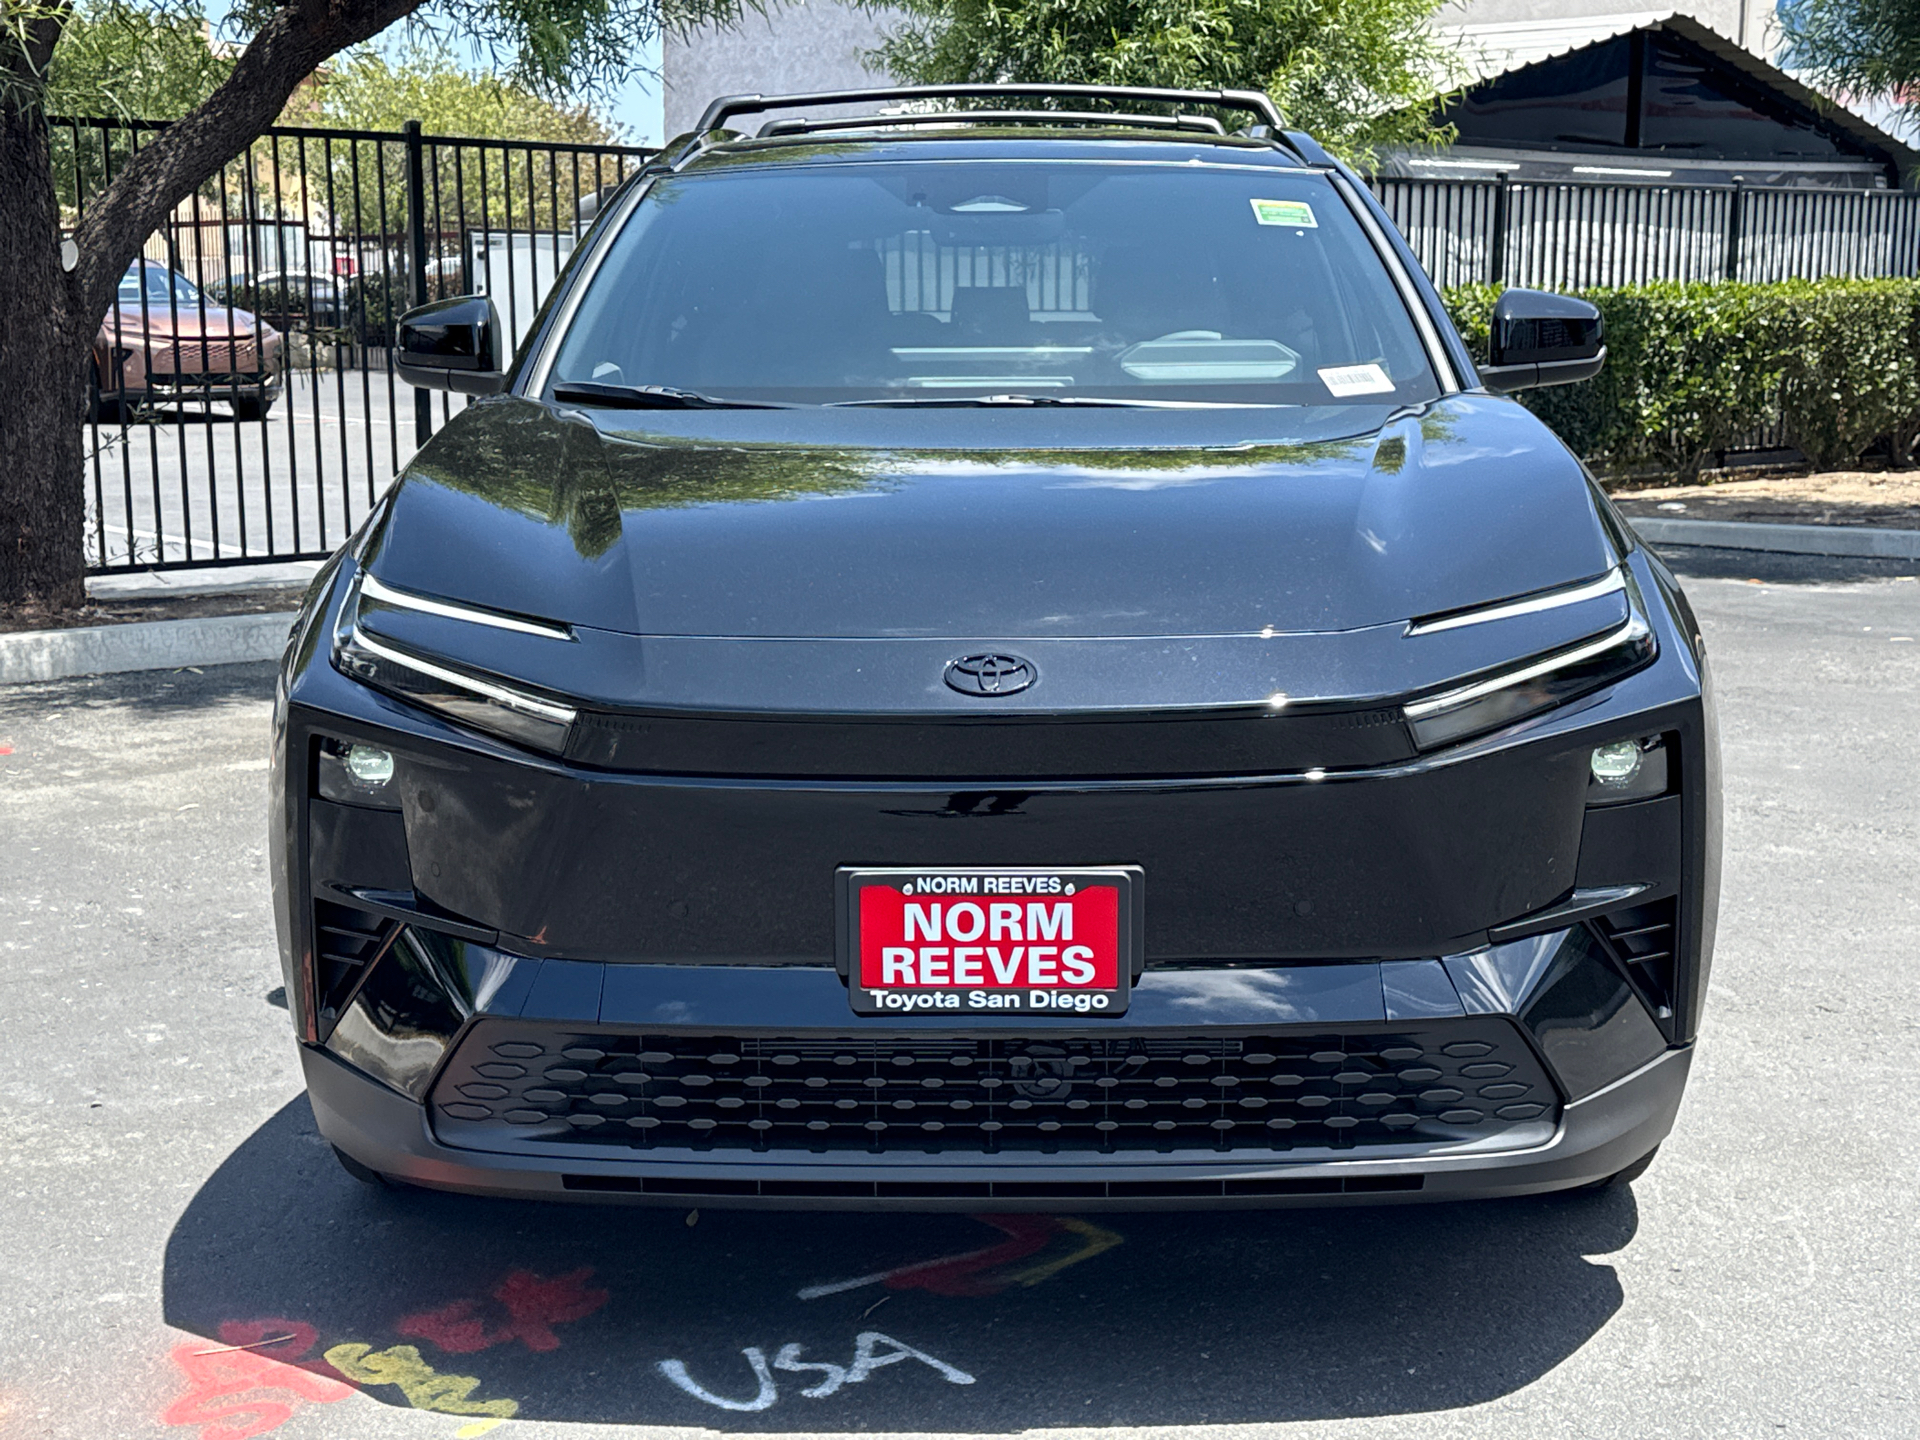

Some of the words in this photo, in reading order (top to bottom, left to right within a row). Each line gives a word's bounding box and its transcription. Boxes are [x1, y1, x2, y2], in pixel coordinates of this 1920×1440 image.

[916, 877, 978, 893] NORM
[983, 877, 1062, 893] REEVES
[904, 902, 1073, 942] NORM
[882, 945, 1095, 985] REEVES
[870, 990, 960, 1012] Toyota
[968, 990, 1020, 1008] San
[1029, 989, 1109, 1012] Diego
[656, 1331, 976, 1411] USA
